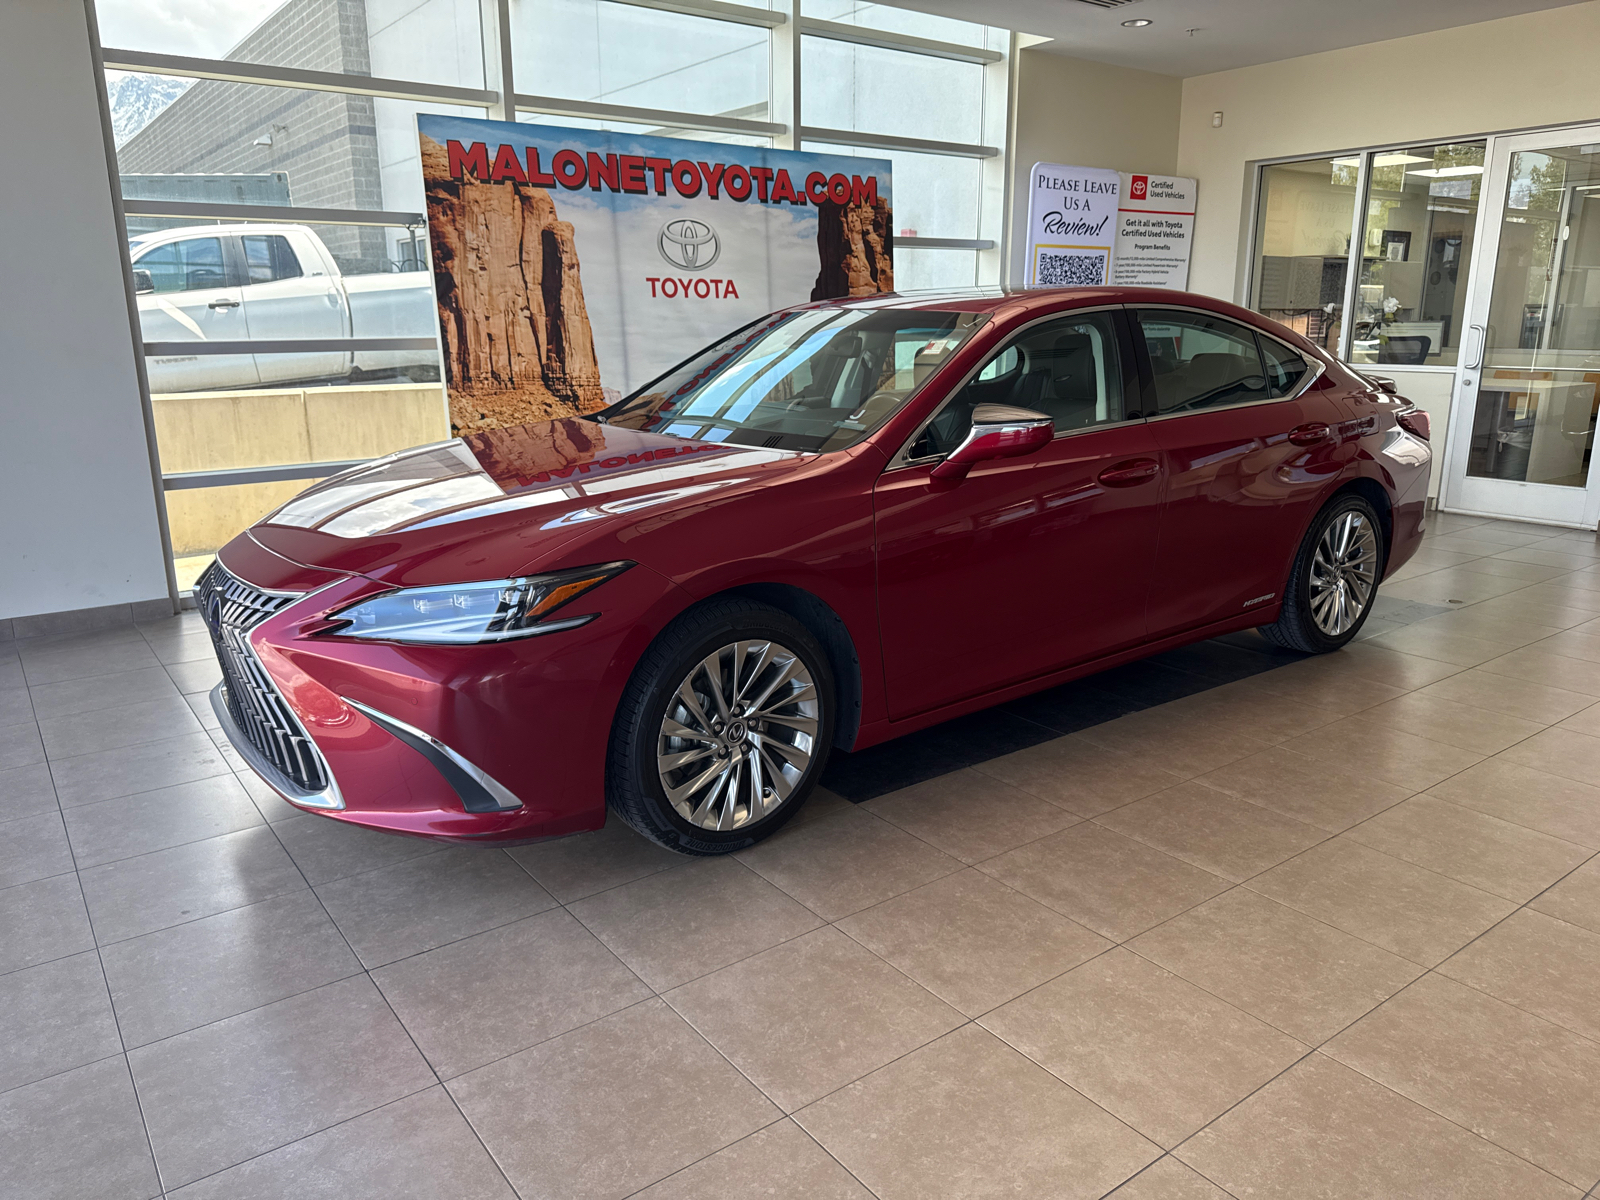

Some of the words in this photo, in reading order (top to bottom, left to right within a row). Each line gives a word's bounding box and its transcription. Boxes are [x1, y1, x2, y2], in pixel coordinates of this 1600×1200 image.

[446, 139, 878, 207] MALONETOYOTA.COM
[1038, 175, 1080, 192] PLEASE
[1084, 179, 1118, 195] LEAVE
[1151, 181, 1174, 189] Certified
[1150, 190, 1163, 198] Used
[1165, 191, 1185, 199] Vehicles
[1064, 197, 1079, 211] US
[1082, 199, 1091, 212] A
[1042, 211, 1109, 236] Review!
[1138, 219, 1142, 227] it
[1151, 220, 1164, 228] with
[1165, 221, 1183, 229] Toyota
[1122, 229, 1147, 237] Certified
[1148, 230, 1162, 238] Used
[1163, 230, 1185, 239] Vehicles
[646, 277, 739, 299] TOYOTA
